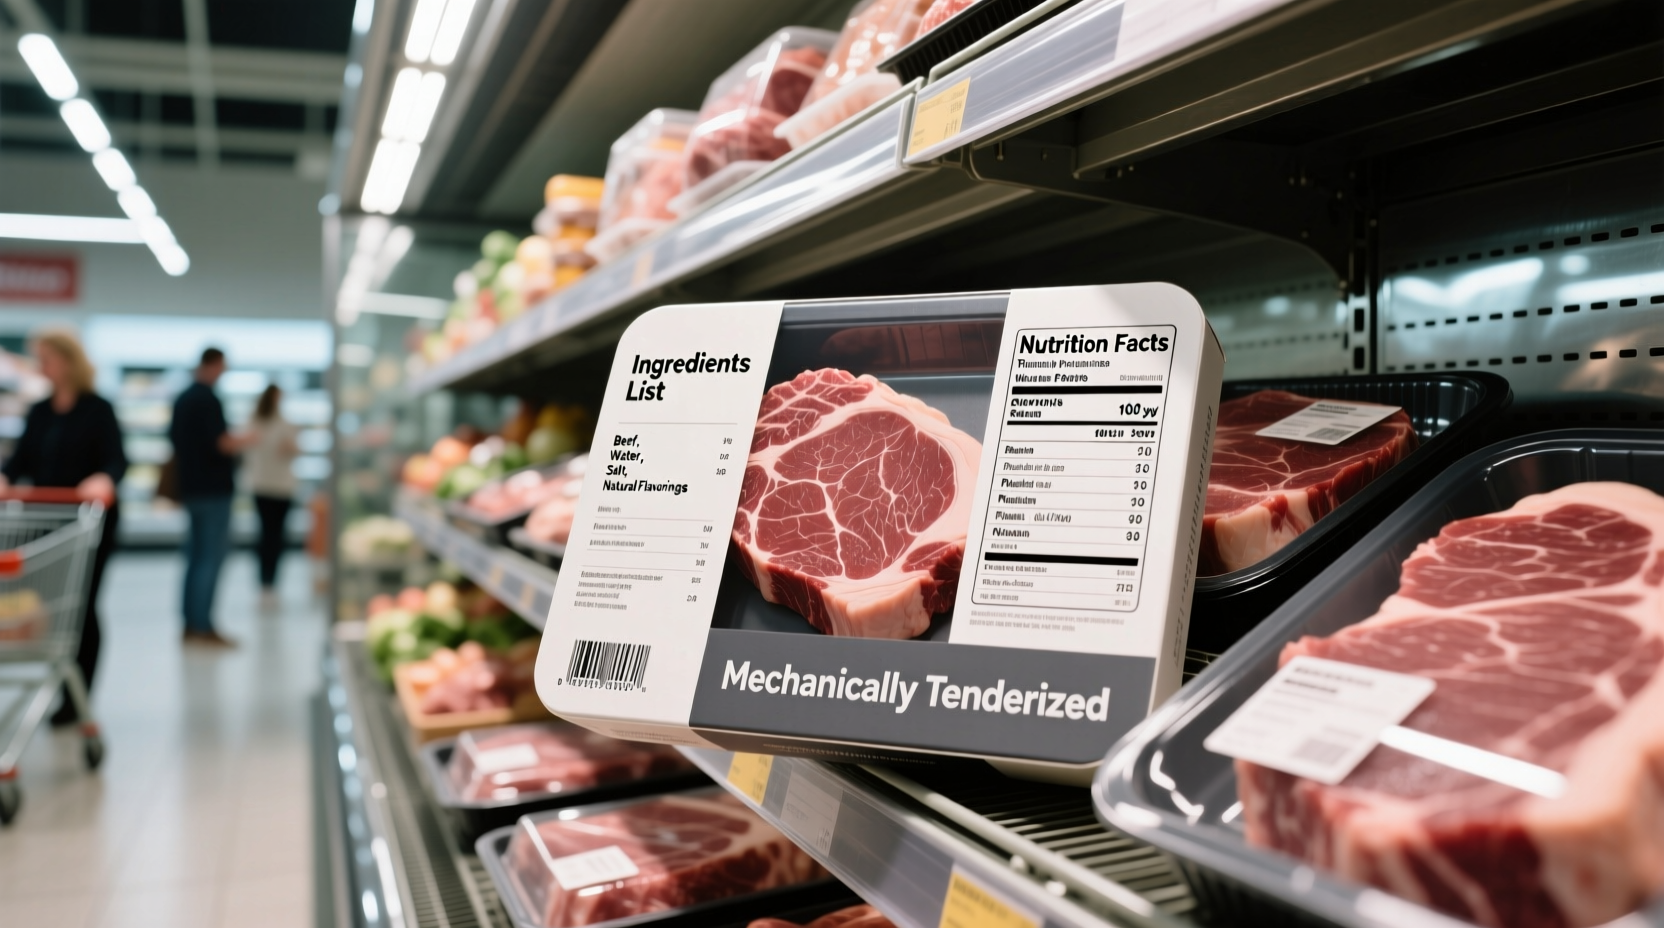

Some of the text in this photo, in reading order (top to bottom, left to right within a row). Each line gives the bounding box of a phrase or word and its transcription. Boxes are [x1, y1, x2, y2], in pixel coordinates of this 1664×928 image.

[1019, 334, 1169, 353] Nutrition Facts
[632, 352, 751, 379] Ingredients
[625, 380, 666, 401] List
[613, 434, 639, 447] Beef,
[610, 449, 644, 464] Water,
[606, 465, 628, 478] Salt,
[602, 480, 688, 496] Natural Flavorings
[721, 660, 1110, 722] Mechanically Tenderized
